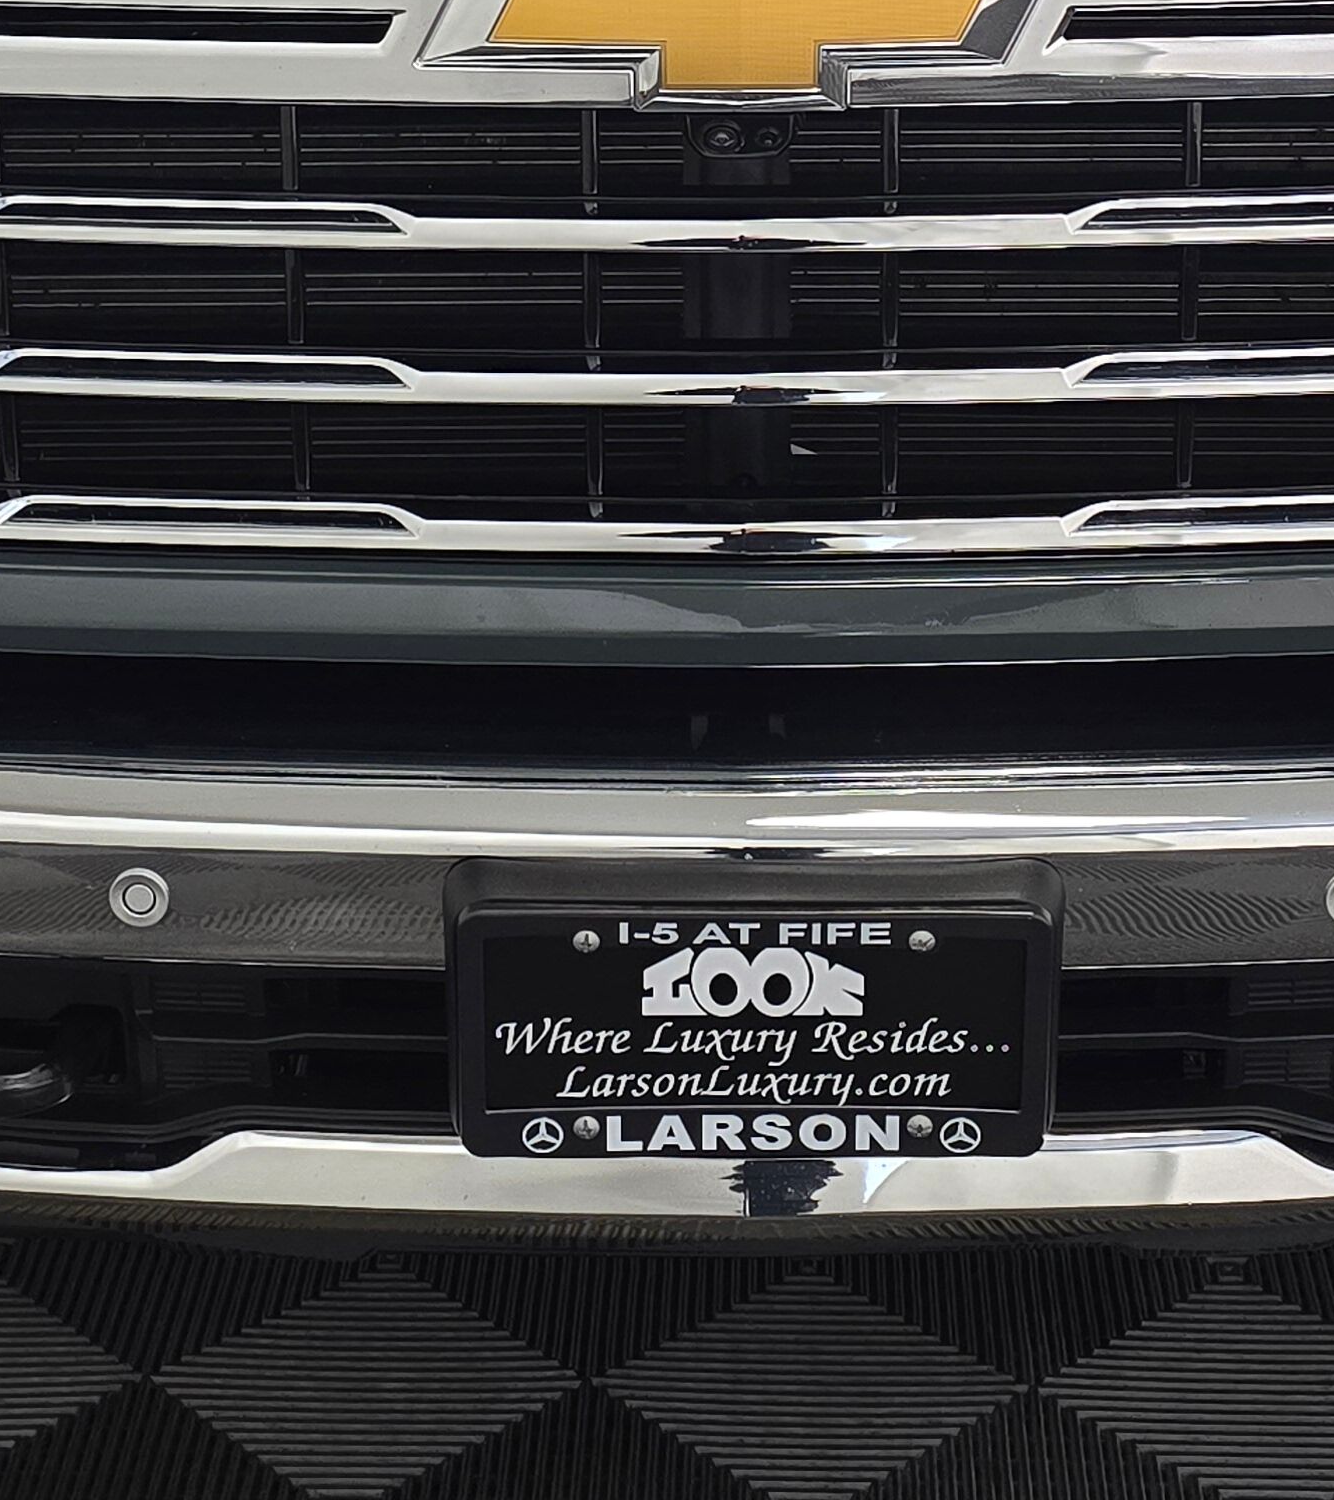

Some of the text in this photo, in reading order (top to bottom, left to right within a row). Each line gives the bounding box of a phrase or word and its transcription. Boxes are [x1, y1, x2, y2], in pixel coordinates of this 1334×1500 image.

[619, 922, 892, 946] I-5 AT FIFE
[641, 947, 865, 1017] LOOK
[495, 1017, 1010, 1067] Where Luxury Resides...
[556, 1065, 952, 1106] LarsonLuxury.com
[605, 1113, 900, 1152] LARSON
